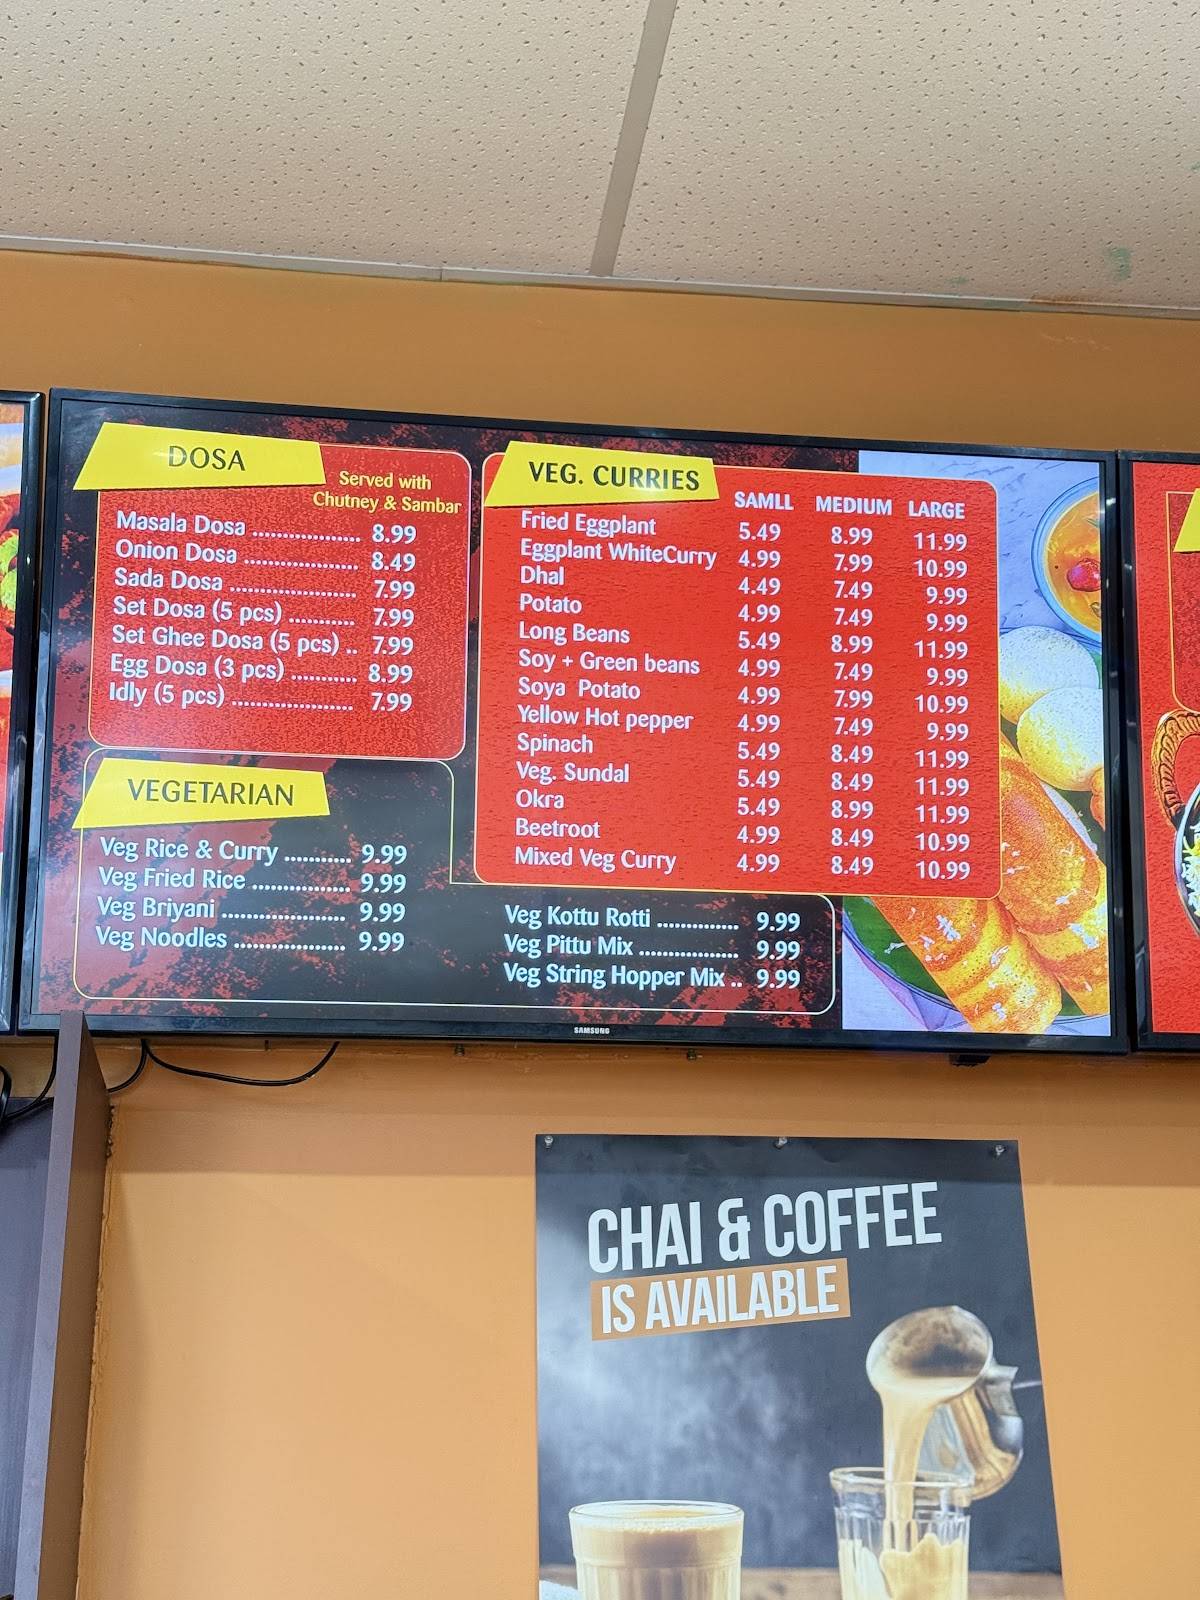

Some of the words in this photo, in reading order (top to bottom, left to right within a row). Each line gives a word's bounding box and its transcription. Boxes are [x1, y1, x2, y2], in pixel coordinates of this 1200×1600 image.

[169, 446, 245, 471] DOSA
[340, 471, 393, 488] Served
[399, 475, 431, 489] with
[529, 462, 583, 484] VEG.
[593, 466, 699, 491] CURRIES
[313, 491, 379, 513] Chutney
[384, 496, 396, 510] &
[402, 497, 462, 513] Sambar
[735, 492, 794, 510] SAMLL
[816, 496, 892, 515] MEDIUM
[909, 501, 965, 519] LARGE
[117, 511, 186, 532] Masala
[195, 515, 245, 535] Dosa
[372, 524, 416, 544] 8.99
[522, 510, 568, 530] Fried
[576, 514, 656, 538] Eggplant
[739, 522, 780, 541] 5.49
[832, 527, 872, 545] 8.99
[914, 533, 967, 551] 11.99
[116, 539, 178, 560] Onion
[186, 543, 236, 564] Dosa
[372, 552, 415, 571] 8.49
[521, 538, 602, 562] Eggplant
[608, 543, 716, 570] WhiteCurry
[739, 550, 780, 568] 4.99
[834, 554, 872, 572] 7.99
[914, 560, 967, 578] 10.99
[115, 567, 163, 587] Sada
[171, 571, 222, 591] Dosa
[375, 580, 414, 599] 7.99
[521, 565, 564, 585] Dhal
[739, 577, 780, 595] 4.49
[834, 581, 872, 599] 7.49
[927, 587, 967, 605] 9.99
[114, 596, 146, 615] Set
[154, 598, 204, 618] Dosa
[213, 598, 232, 622] (5
[240, 601, 281, 626] pcs)
[374, 608, 414, 627] 7.99
[520, 593, 581, 613] Potato
[739, 604, 780, 622] 4.99
[834, 608, 872, 626] 7.49
[927, 614, 967, 632] 9.99
[113, 625, 145, 644] Set
[153, 626, 204, 647] Ghee
[212, 630, 263, 649] Dosa
[270, 629, 290, 653] (5
[298, 632, 339, 657] pcs)
[373, 636, 413, 655] 7.99
[520, 621, 567, 645] Long
[573, 624, 630, 643] Beans
[739, 631, 780, 650] 5.49
[831, 635, 872, 653] 8.99
[915, 640, 967, 659] 11.99
[111, 654, 148, 678] Egg
[156, 656, 206, 676] Dosa
[215, 655, 234, 679] (3
[242, 658, 284, 683] pcs)
[368, 664, 412, 683] 8.99
[519, 649, 556, 673] Soy
[562, 656, 573, 666] +
[580, 652, 637, 671] Green
[645, 654, 700, 674] beans
[738, 659, 780, 677] 4.99
[835, 663, 872, 681] 7.49
[927, 668, 968, 686] 9.99
[110, 681, 147, 707] Idly
[154, 681, 174, 705] (5
[182, 684, 224, 709] pcs)
[372, 692, 412, 712] 7.99
[519, 677, 565, 700] Soya
[579, 679, 640, 699] Potato
[738, 687, 780, 704] 4.99
[835, 690, 873, 708] 7.99
[915, 695, 968, 713] 10.99
[518, 705, 579, 724] Yellow
[586, 708, 620, 726] Hot
[626, 714, 693, 733] pepper
[738, 714, 780, 732] 4.99
[835, 717, 873, 736] 7.49
[928, 723, 968, 741] 9.99
[518, 733, 593, 756] Spinach
[738, 742, 780, 760] 5.49
[832, 744, 873, 763] 8.49
[915, 750, 969, 769] 11.99
[128, 779, 293, 806] VEGETARIAN
[516, 761, 556, 785] Veg.
[565, 763, 629, 782] Sundal
[738, 769, 780, 788] 5.49
[832, 773, 873, 791] 8.49
[916, 777, 969, 796] 11.99
[516, 789, 564, 808] Okra
[738, 797, 780, 816] 5.49
[832, 800, 873, 819] 8.99
[916, 805, 969, 824] 11.99
[516, 818, 600, 838] Beetroot
[737, 826, 780, 844] 4.99
[832, 828, 873, 847] 8.49
[916, 833, 969, 851] 10.99
[100, 837, 138, 862] Veg
[146, 838, 188, 858] Rice
[196, 840, 212, 859] &
[219, 841, 278, 866] Curry
[362, 844, 407, 864] 9.99
[516, 847, 572, 866] Mixed
[580, 849, 615, 873] Veg
[621, 850, 676, 874] Curry
[737, 854, 780, 872] 4.99
[832, 856, 873, 875] 8.49
[916, 861, 970, 879] 10.99
[99, 867, 137, 892] Veg
[144, 868, 194, 887] Fried
[203, 870, 245, 889] Rice
[361, 873, 406, 893] 9.99
[97, 896, 136, 921] Veg
[143, 897, 214, 922] Briyani
[360, 902, 405, 922] 9.99
[505, 905, 542, 929] Veg
[548, 906, 598, 925] Kottu
[606, 908, 650, 927] Rotti
[757, 912, 800, 931] 9.99
[96, 926, 134, 951] Veg
[141, 927, 227, 948] Noodles
[359, 932, 404, 951] 9.99
[504, 934, 541, 959] Veg
[547, 935, 591, 954] Pittu
[598, 936, 633, 955] Mix
[757, 940, 800, 960] 9.99
[504, 963, 540, 987] Veg
[546, 964, 606, 989] String
[612, 965, 685, 990] Hopper
[691, 967, 725, 986] Mix
[757, 969, 800, 988] 9.99
[587, 1201, 702, 1273] CHAI
[718, 1198, 750, 1260] &
[763, 1181, 942, 1258] COFFEE
[600, 1284, 635, 1334] IS
[645, 1265, 838, 1329] AVAILABLE
